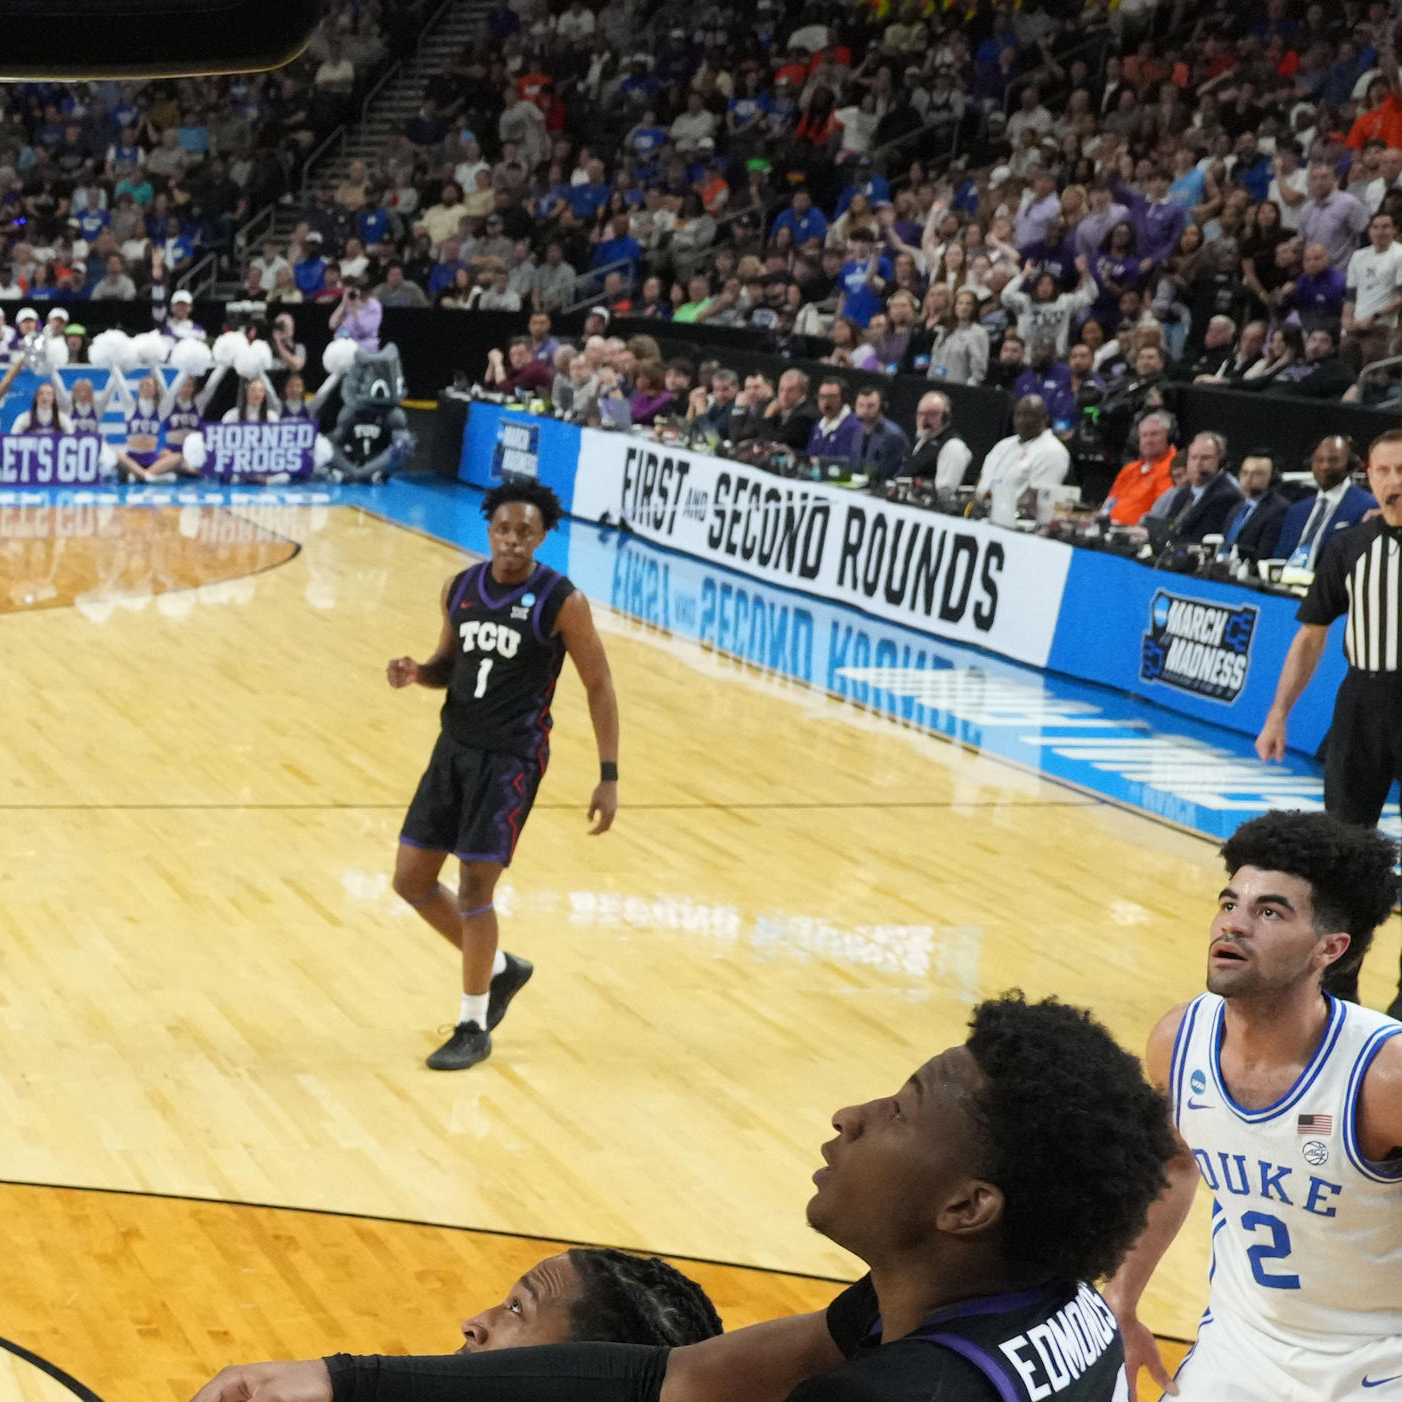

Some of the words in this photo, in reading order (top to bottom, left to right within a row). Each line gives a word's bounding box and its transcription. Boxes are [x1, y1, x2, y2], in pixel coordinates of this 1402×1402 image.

[57, 436, 99, 483] GO
[205, 424, 315, 451] HORNED
[214, 449, 302, 473] FROGS
[622, 447, 690, 535] FIRST
[684, 485, 708, 522] AND
[707, 472, 831, 580] SECOND
[837, 505, 1005, 632] ROUNDS
[459, 620, 522, 659] TCU
[1166, 599, 1229, 647] MARCH
[473, 658, 494, 699] 1
[1164, 637, 1248, 691] MADNESS
[1192, 1148, 1342, 1217] DUKE
[1241, 1210, 1301, 1289] 2
[998, 1280, 1118, 1402] EDMONDS
